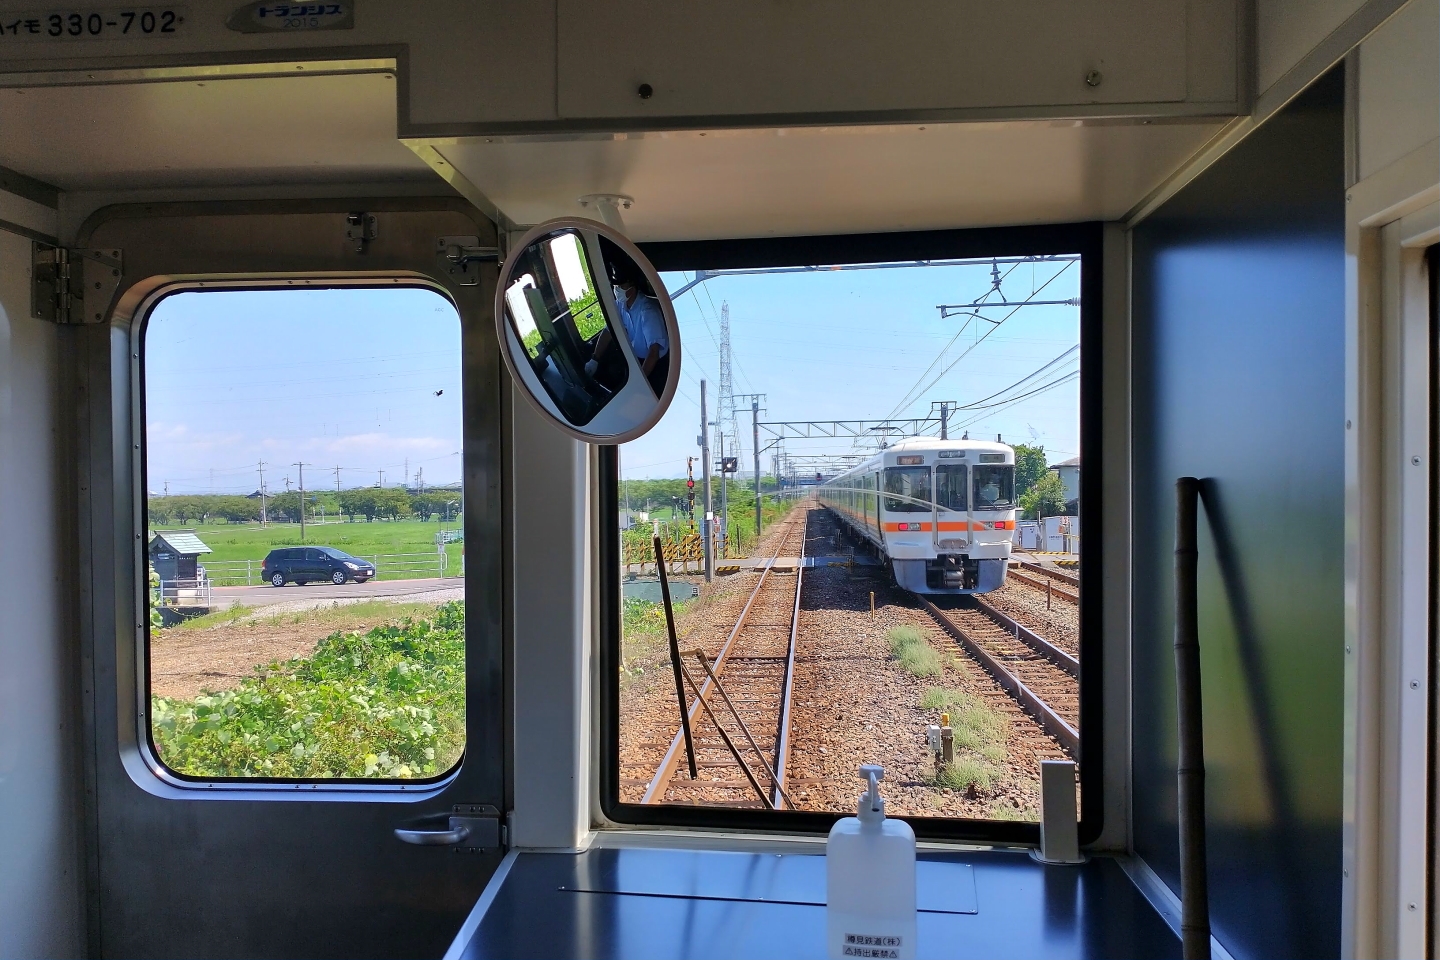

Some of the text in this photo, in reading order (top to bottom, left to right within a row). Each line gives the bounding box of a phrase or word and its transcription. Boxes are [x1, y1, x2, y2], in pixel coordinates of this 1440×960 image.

[259, 5, 342, 17] トランシス
